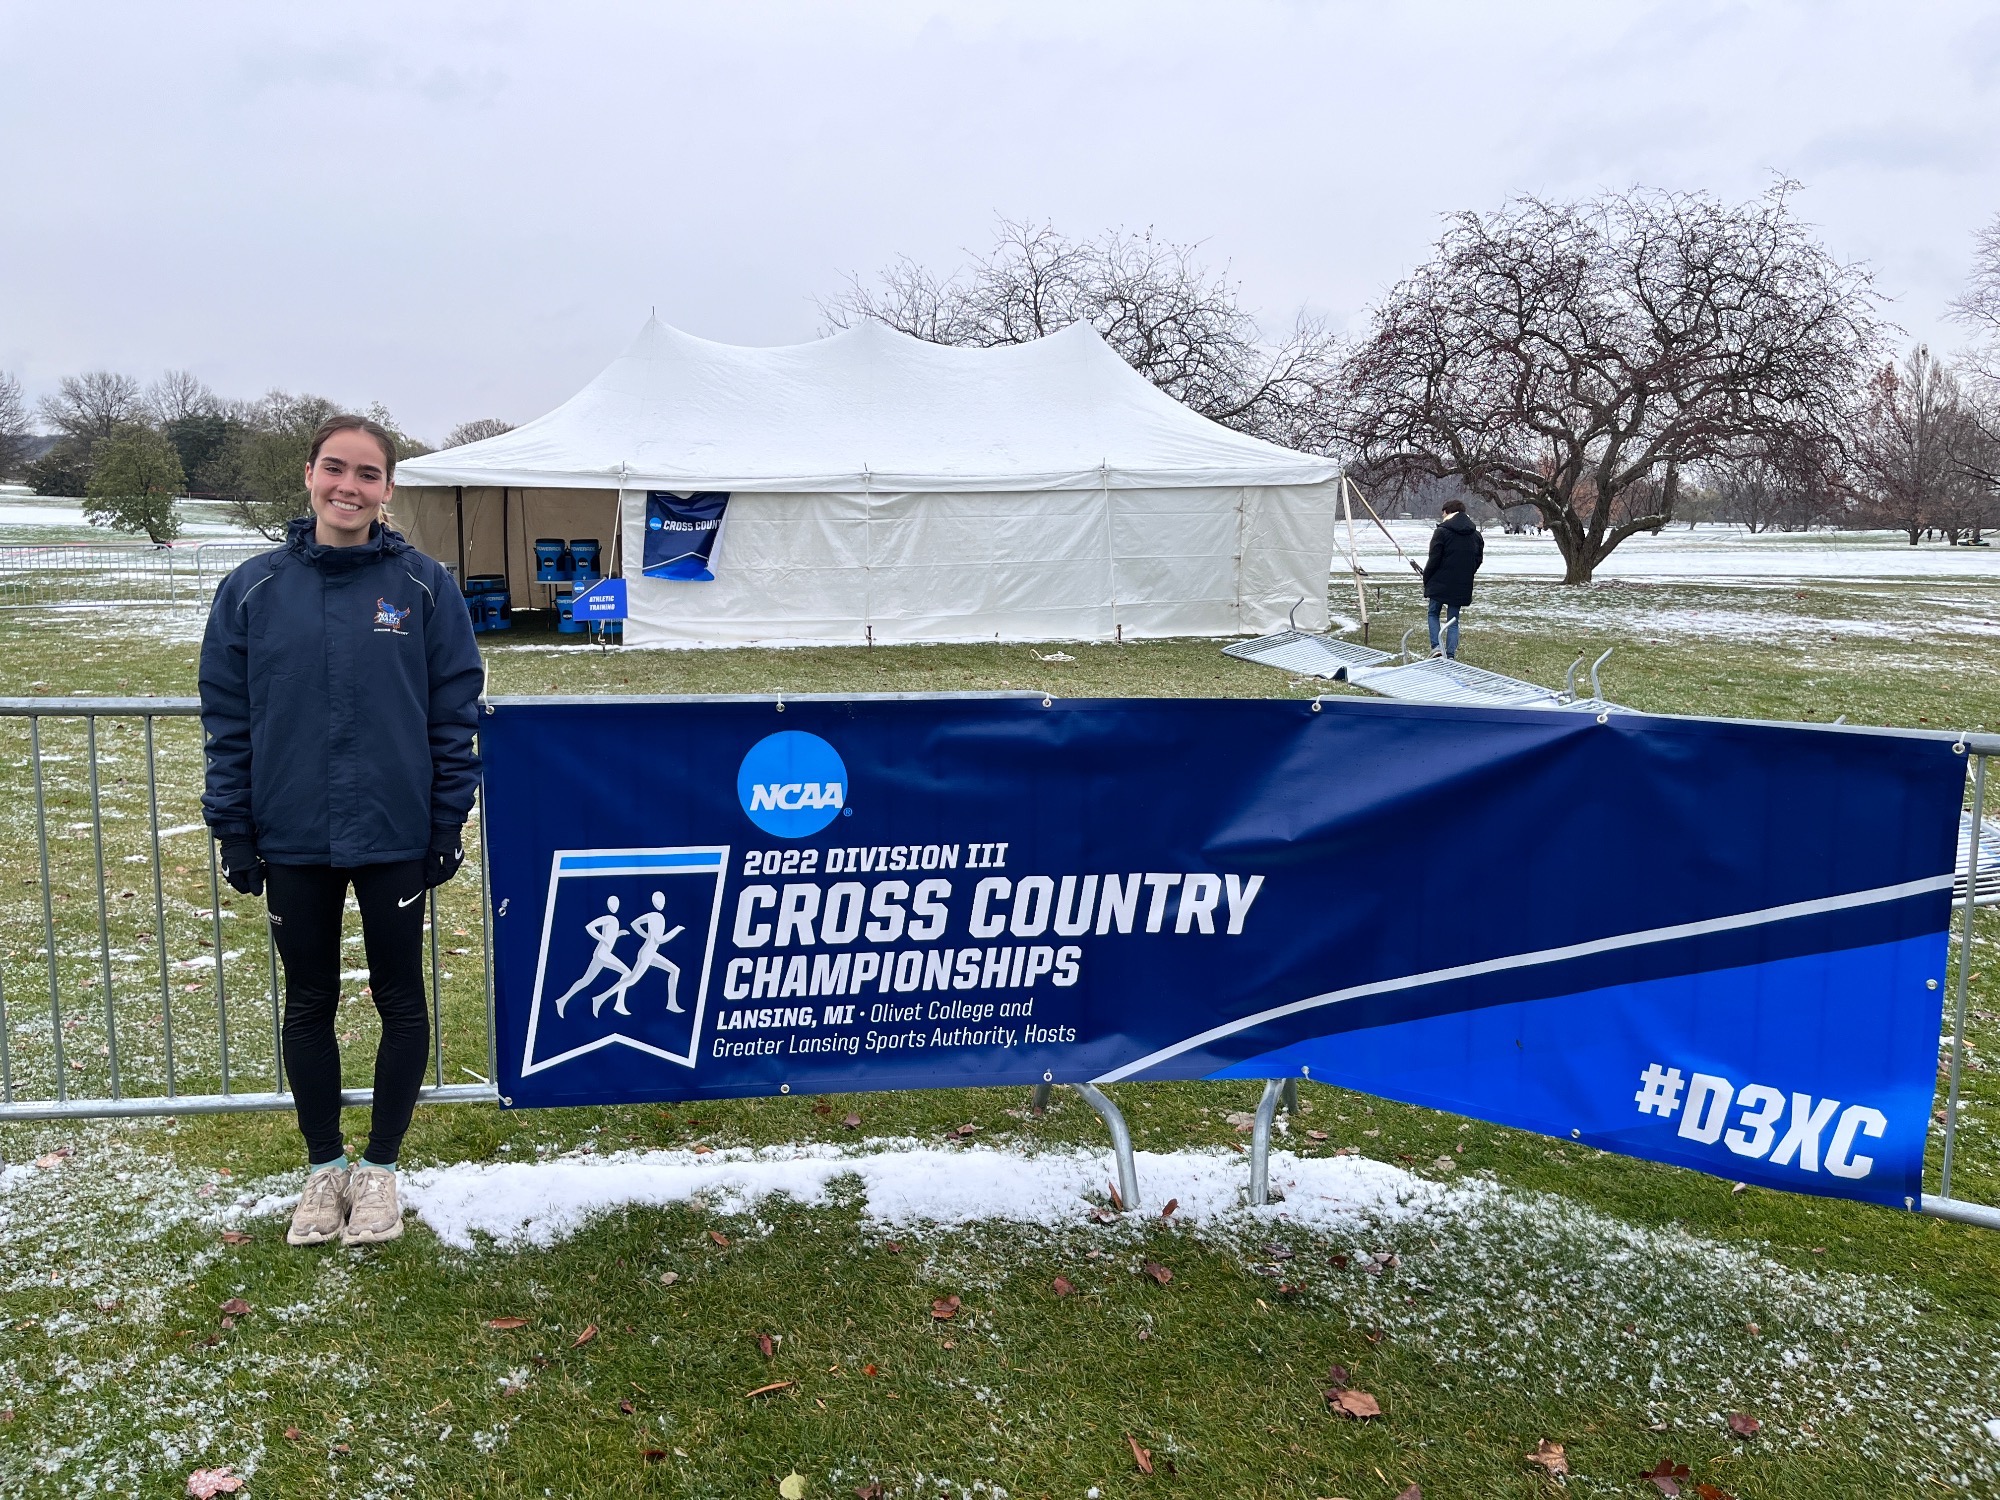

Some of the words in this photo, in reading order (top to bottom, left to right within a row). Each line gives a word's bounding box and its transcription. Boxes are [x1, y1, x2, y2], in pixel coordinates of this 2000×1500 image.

[663, 520, 694, 531] CROSS
[589, 595, 615, 603] ATHLETIC
[589, 603, 615, 611] TRAINING
[750, 783, 843, 810] NCAA
[744, 849, 818, 875] 2022
[825, 844, 959, 872] DIVISION
[965, 843, 1008, 868] III
[732, 879, 952, 947] CROSS
[969, 873, 1265, 938] COUNTRY
[724, 946, 1082, 1000] CHAMPIONSHIPS
[715, 1006, 818, 1031] LANSING,
[822, 1004, 856, 1026] MI
[869, 1001, 924, 1024] Olivet
[927, 999, 995, 1023] College
[998, 996, 1035, 1018] and
[711, 1036, 785, 1058] Greater
[788, 1031, 860, 1055] Lansing
[864, 1029, 926, 1052] Sports
[929, 1024, 1018, 1049] Authority,
[1023, 1023, 1077, 1044] Hosts
[1635, 1063, 1887, 1180] #D3XC
